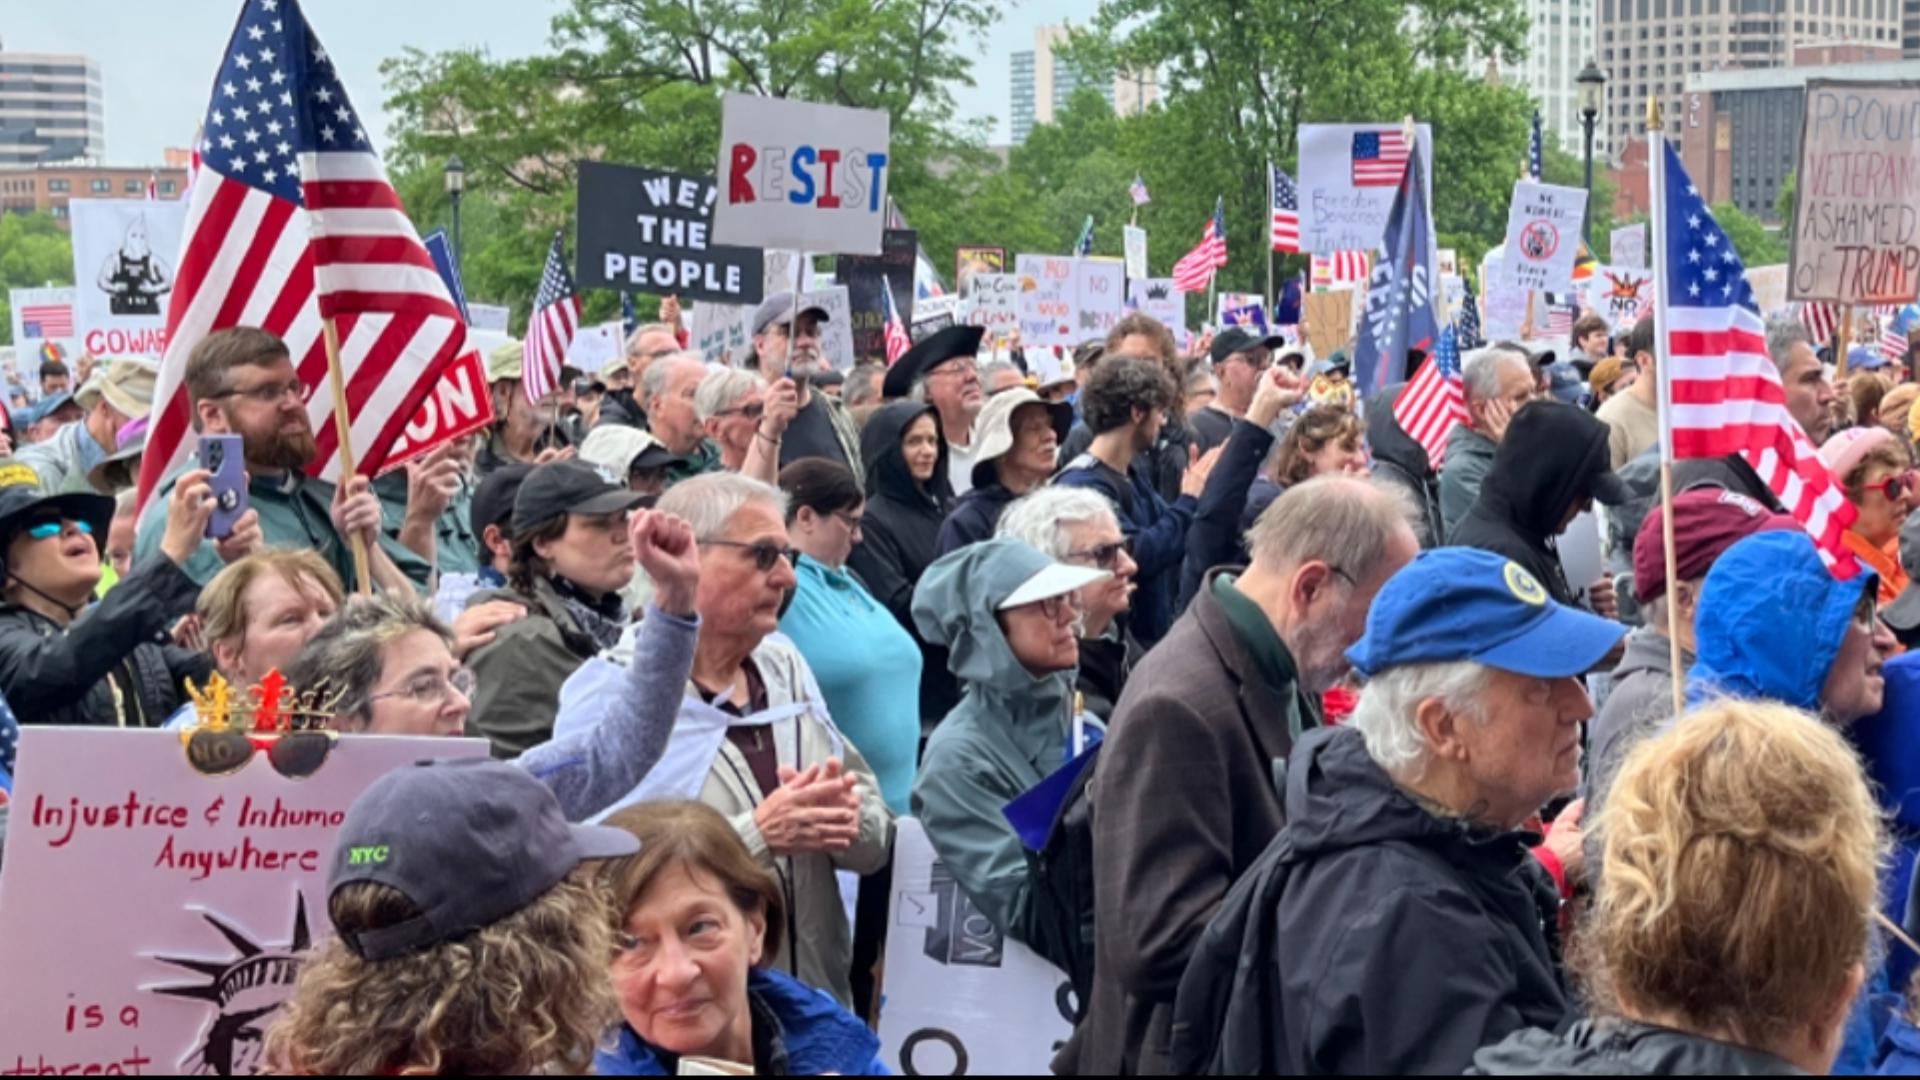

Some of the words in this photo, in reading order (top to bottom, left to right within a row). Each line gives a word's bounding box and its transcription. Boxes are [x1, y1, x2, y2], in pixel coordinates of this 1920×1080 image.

[641, 176, 717, 215] WE!
[729, 143, 886, 212] RESIST
[1809, 151, 1916, 199] VETERAN
[637, 214, 707, 250] THE
[1802, 201, 1917, 246] ASHAMED
[604, 253, 741, 293] PEOPLE
[1834, 245, 1920, 298] TRUMP
[1610, 298, 1637, 314] NO
[389, 365, 478, 457] ON
[32, 790, 190, 848] Injustice
[154, 834, 319, 880] Anywhere
[348, 845, 390, 865] NYC
[66, 992, 105, 1032] is
[119, 1003, 139, 1028] a
[1, 1044, 150, 1076] threat
